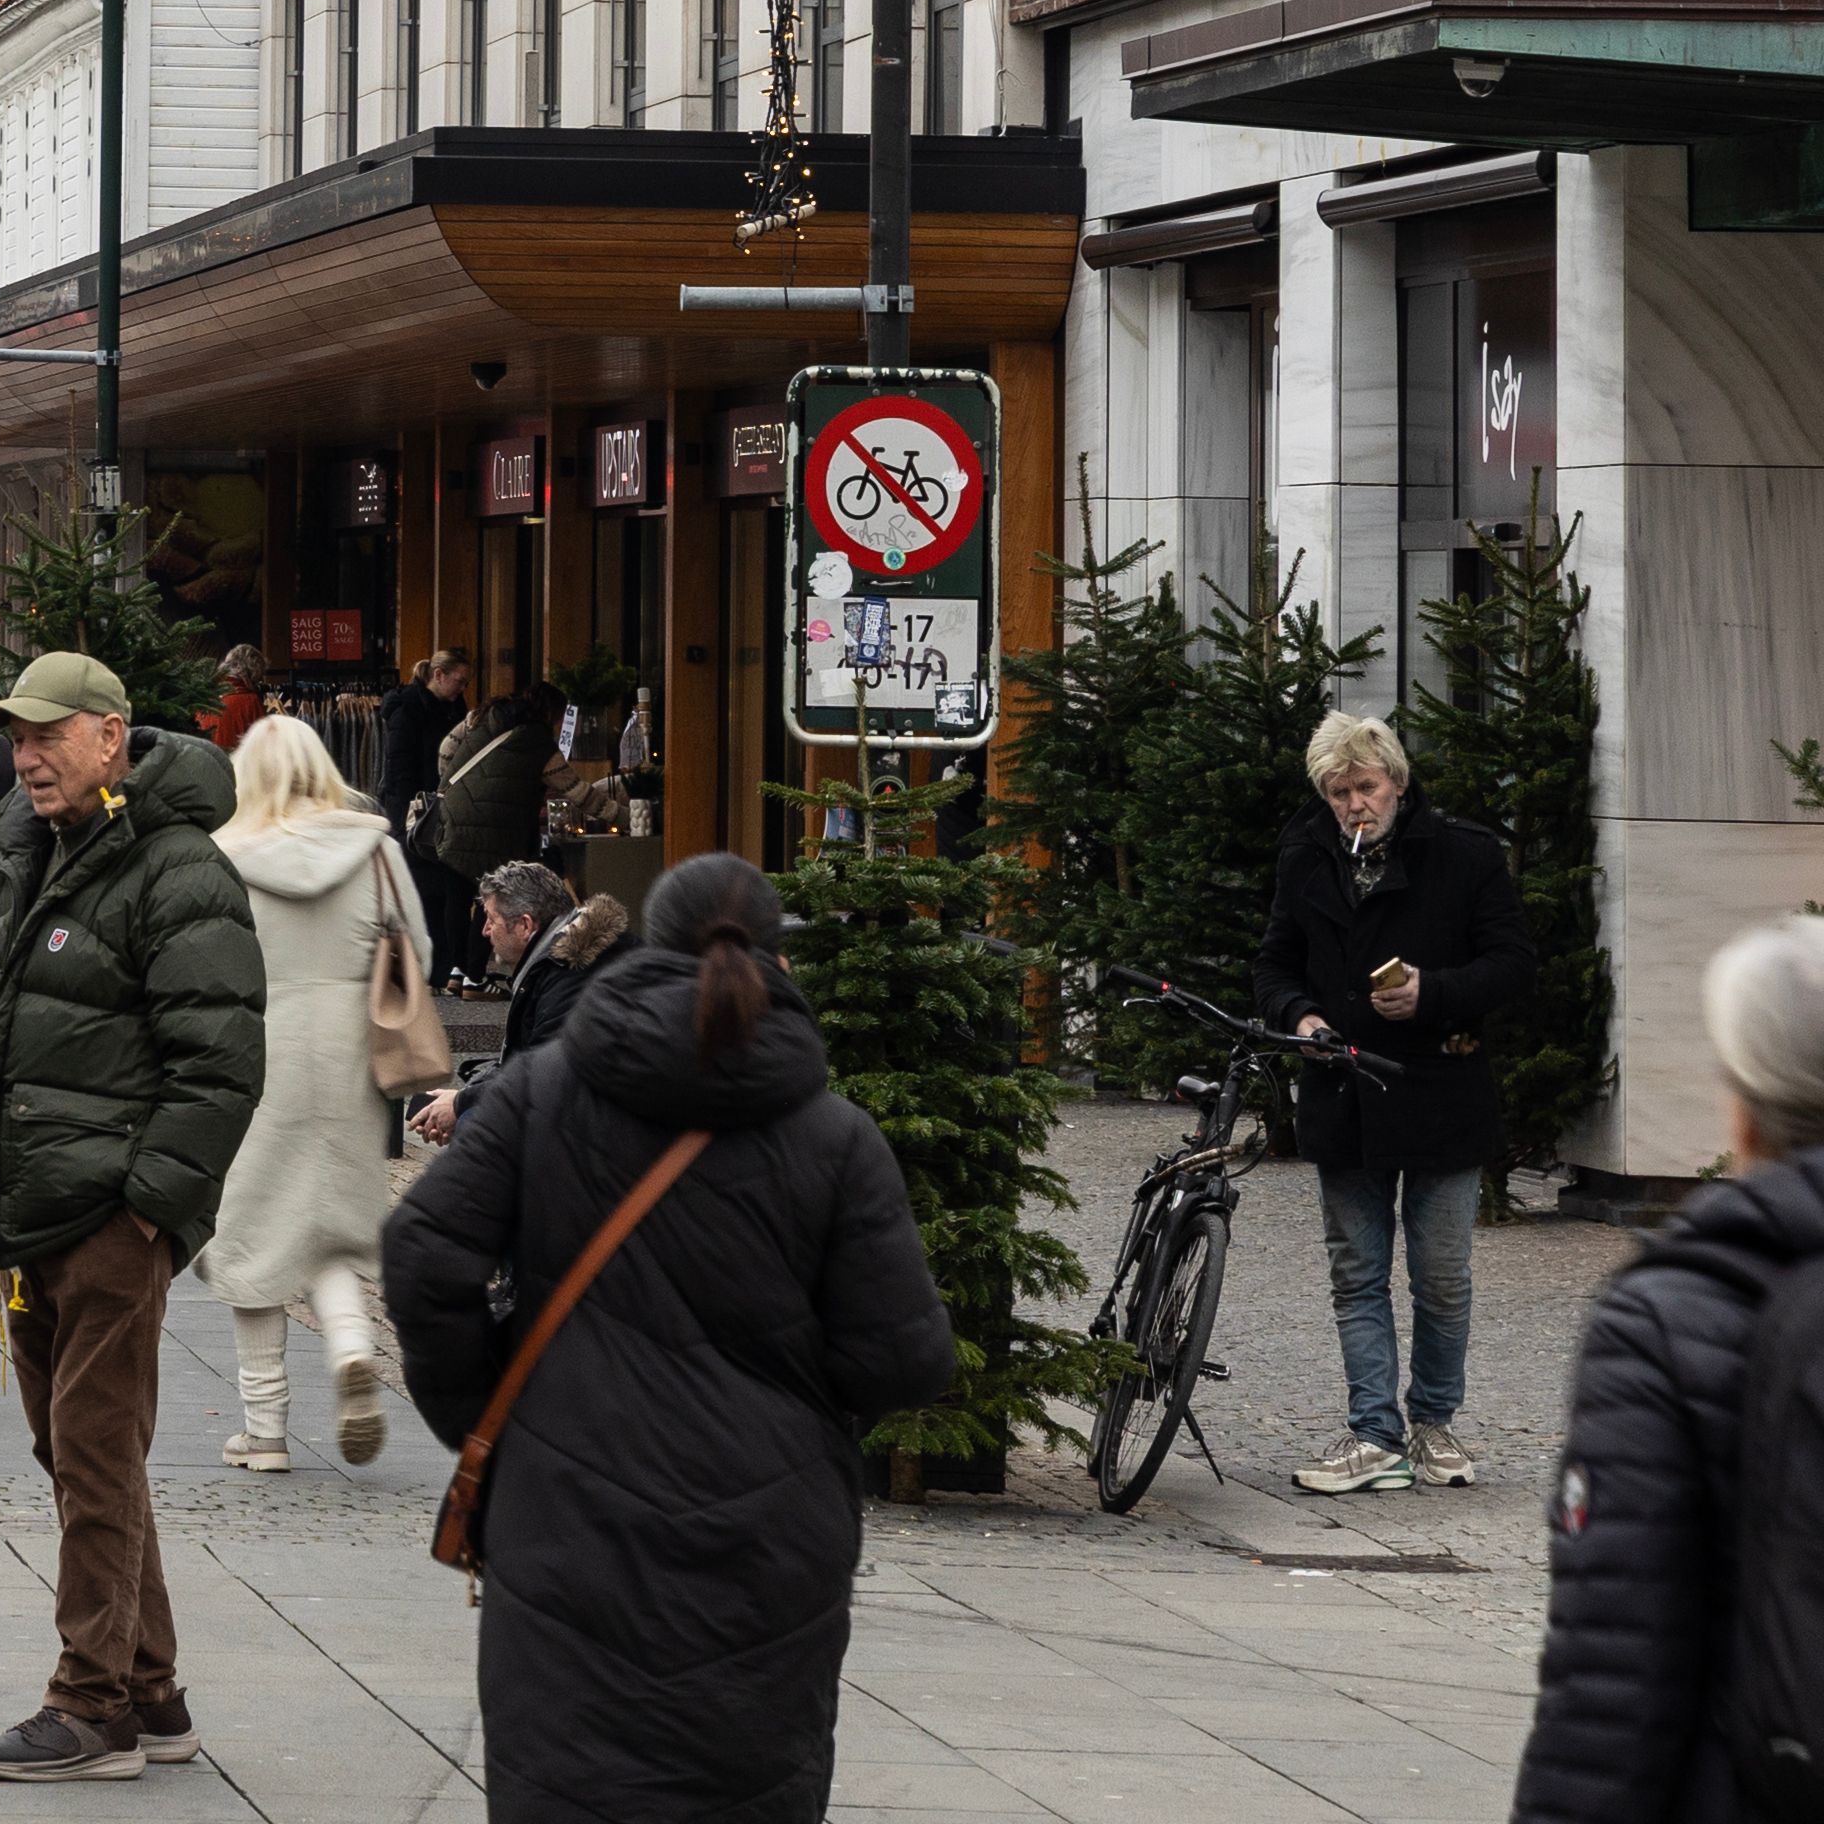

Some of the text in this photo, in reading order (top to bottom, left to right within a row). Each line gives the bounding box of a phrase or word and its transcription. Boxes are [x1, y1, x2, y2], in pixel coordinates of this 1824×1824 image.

[602, 428, 641, 500] UPSTAIRS
[291, 617, 322, 628] SALG
[292, 629, 323, 640] SALG
[292, 641, 323, 653] SALG
